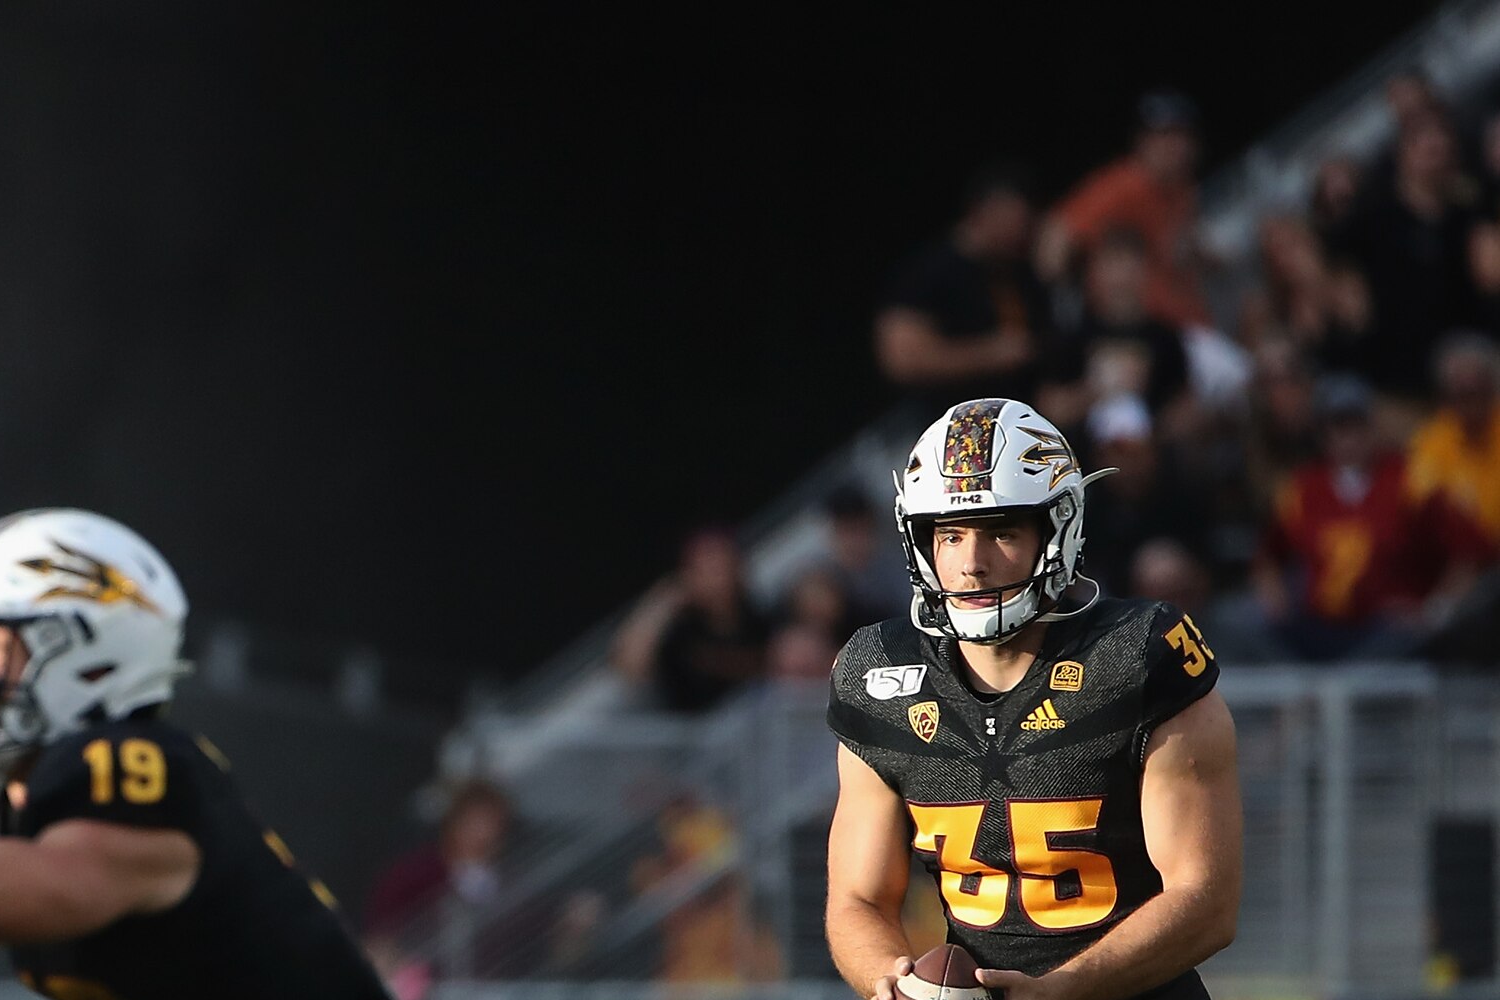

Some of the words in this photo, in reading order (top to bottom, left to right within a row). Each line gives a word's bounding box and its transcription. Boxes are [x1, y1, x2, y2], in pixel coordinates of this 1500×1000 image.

[862, 665, 927, 700] 150
[918, 719, 934, 735] 12
[1020, 718, 1066, 731] adidas
[82, 738, 167, 804] 19
[906, 798, 1118, 932] 35
